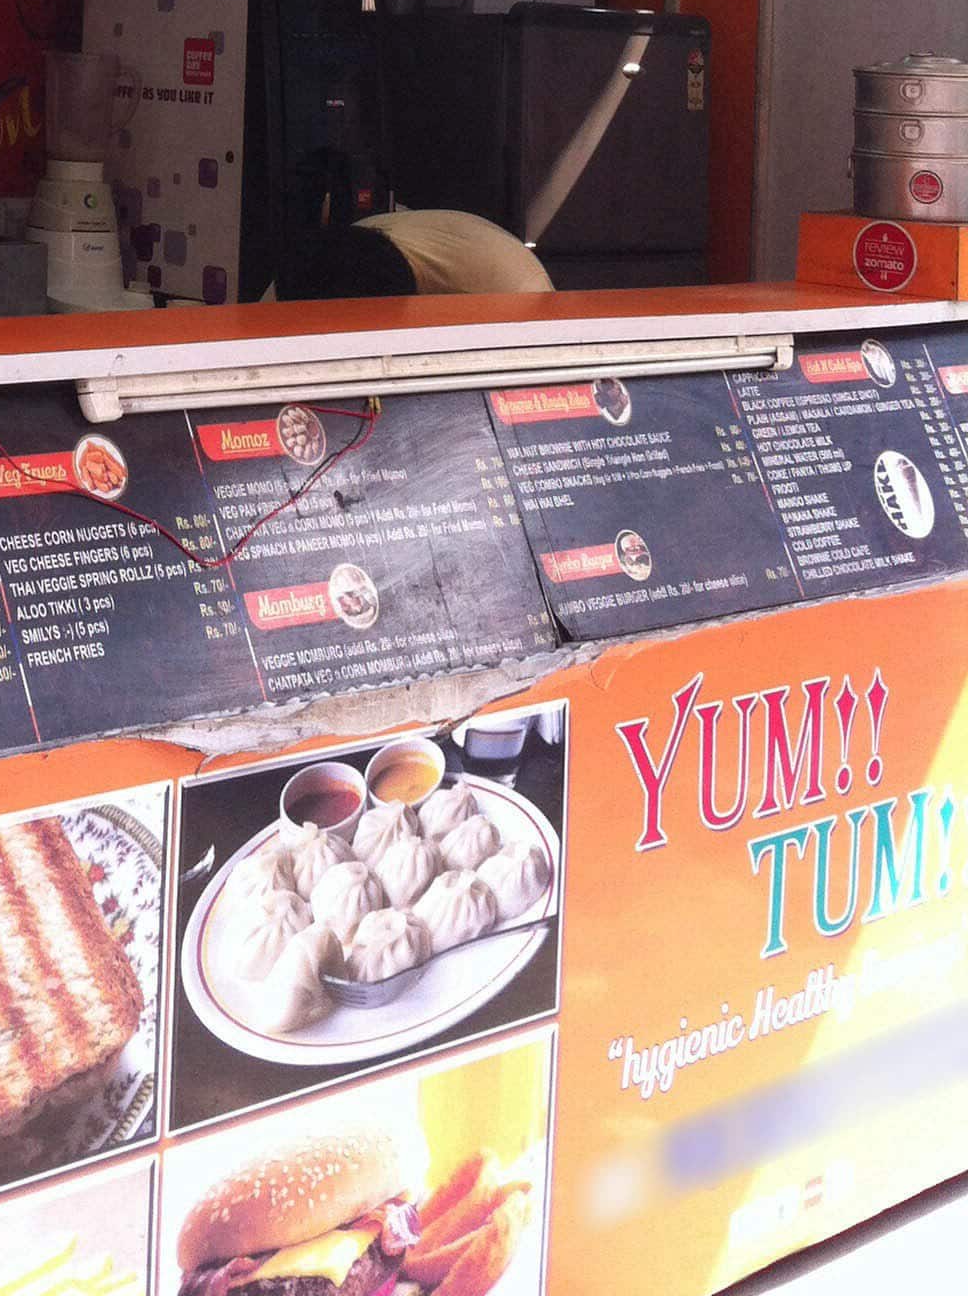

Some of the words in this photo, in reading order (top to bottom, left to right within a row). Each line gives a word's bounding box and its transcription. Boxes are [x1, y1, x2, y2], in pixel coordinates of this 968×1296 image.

[864, 257, 905, 272] zomato
[221, 430, 272, 451] Momoz
[0, 533, 44, 553] CHEESE
[44, 528, 76, 546] CORN
[77, 522, 126, 544] NUGGETS
[3, 557, 28, 576] VEG
[29, 551, 73, 573] CHEESE
[73, 546, 121, 567] FINGERS
[9, 580, 37, 599] THAI
[36, 574, 79, 595] VEGGIE
[79, 568, 119, 589] SPRING
[119, 564, 154, 582] ROLLZ
[16, 603, 48, 622] ALOO
[48, 598, 78, 617] TIKKI
[21, 624, 67, 645] SMILYS
[27, 647, 73, 669] FRENCH
[73, 641, 106, 662] FRIES
[262, 653, 297, 673] VEGGIE
[268, 672, 314, 692] CHATPATA
[615, 667, 889, 854] YUM!!
